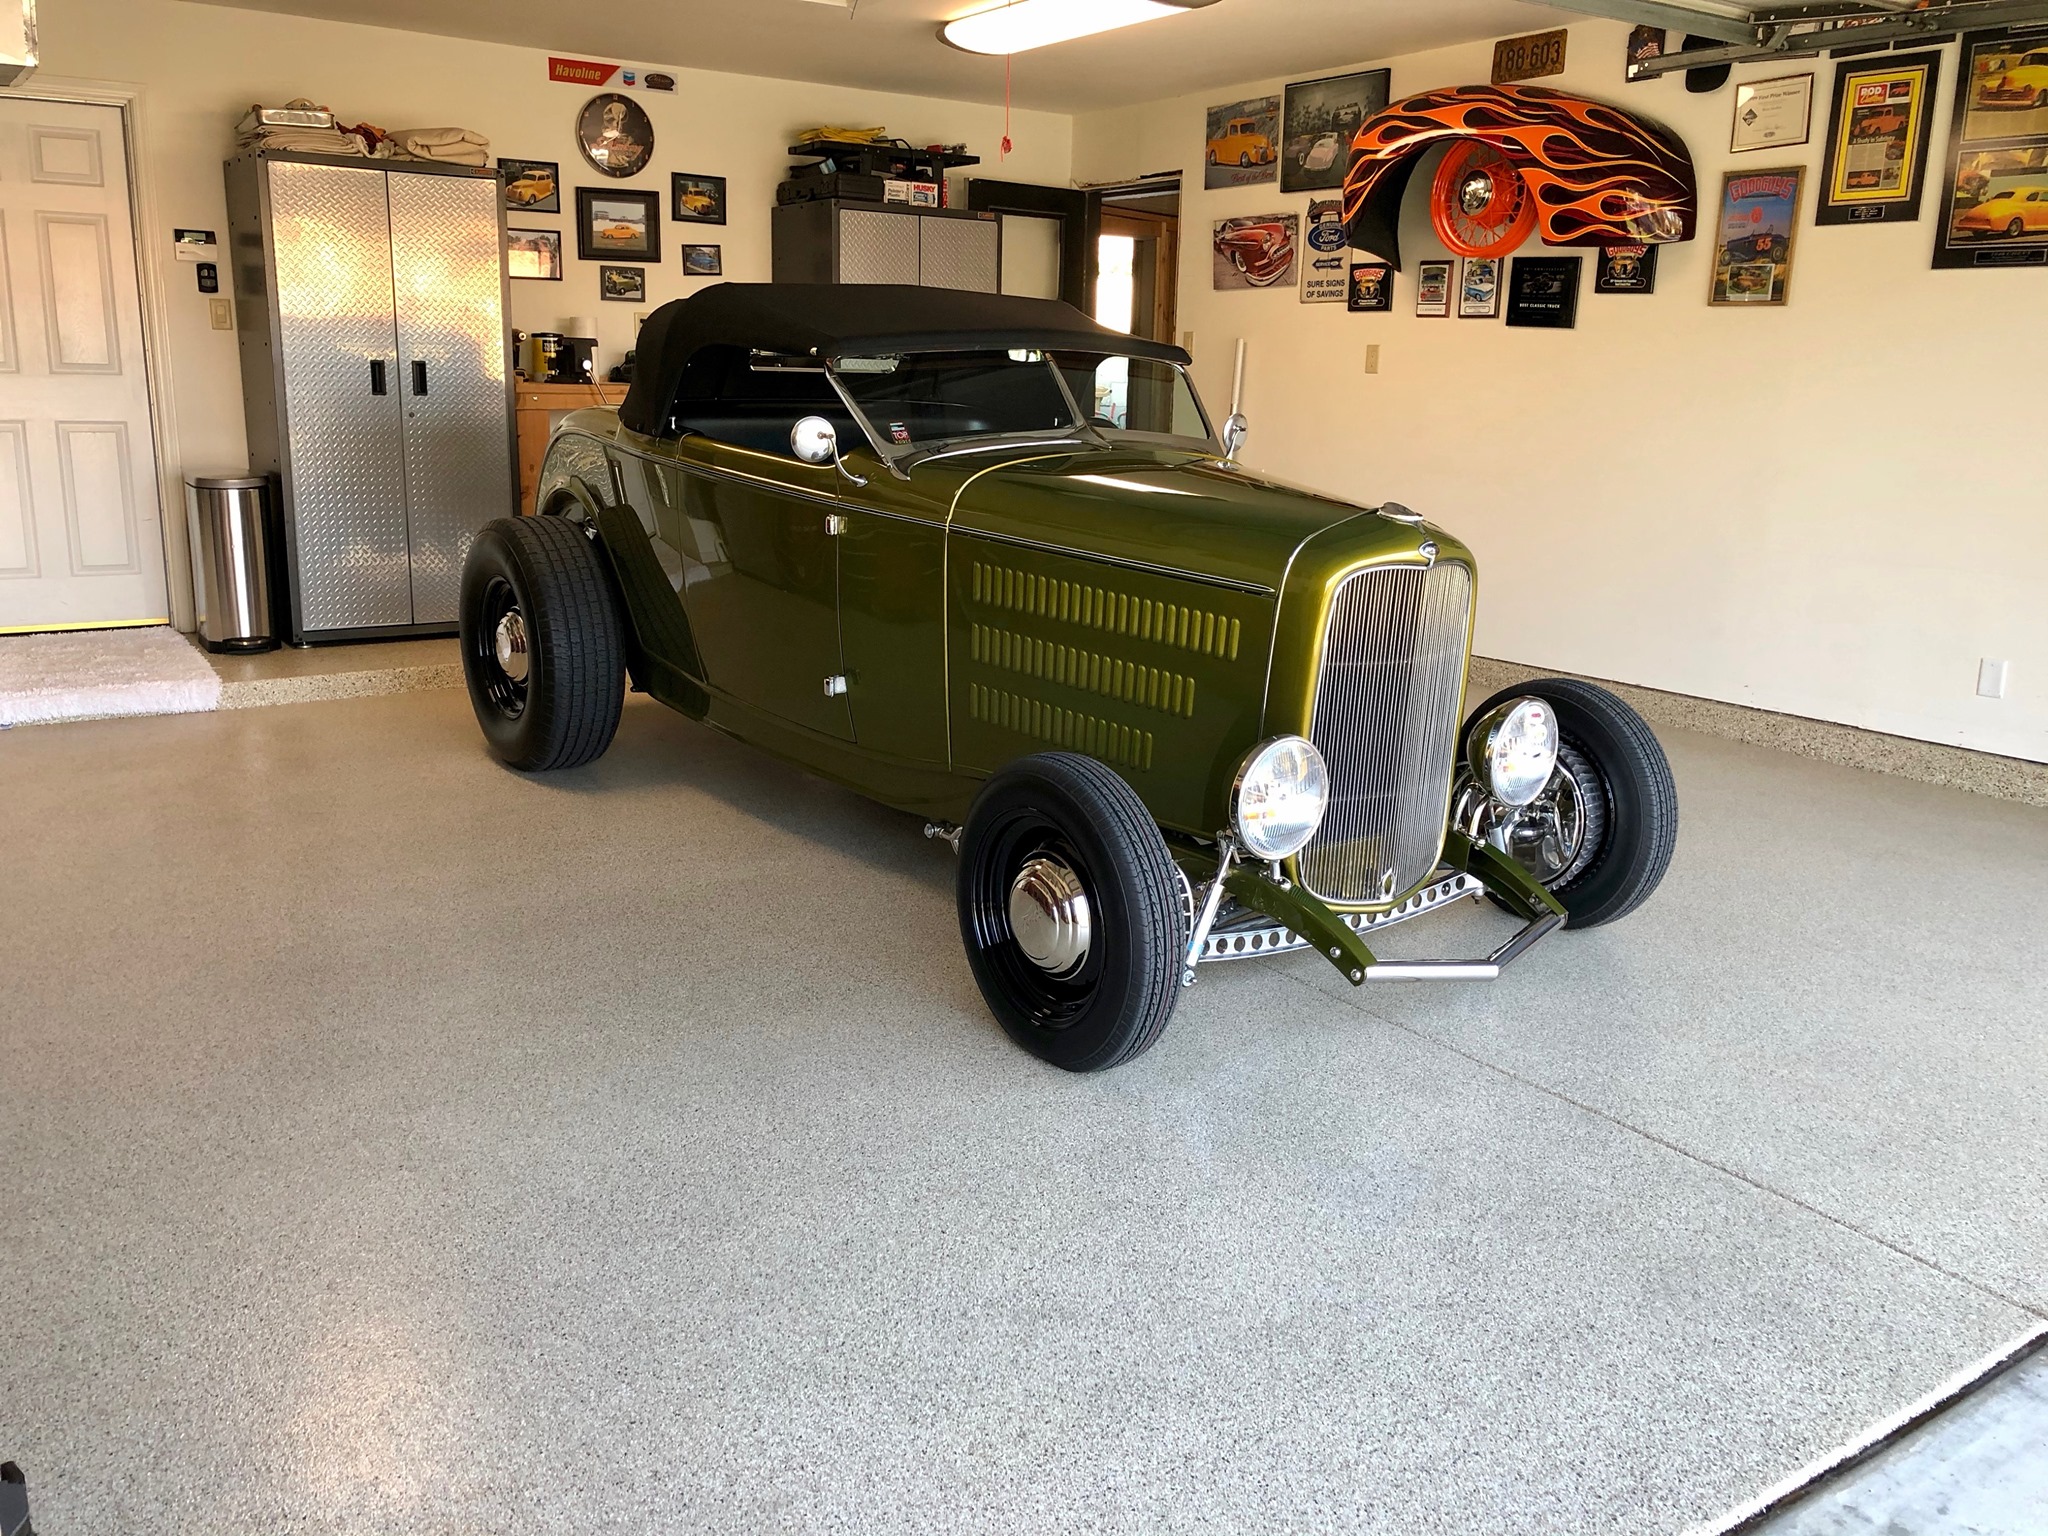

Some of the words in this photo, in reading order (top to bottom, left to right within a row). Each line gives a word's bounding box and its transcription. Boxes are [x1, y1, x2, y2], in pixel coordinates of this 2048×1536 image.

[555, 64, 601, 80] Havoline
[1860, 86, 1882, 96] ROD
[913, 184, 936, 192] HUSKY
[1728, 176, 1798, 204] GOODGUYS
[1319, 230, 1340, 242] Ford
[1756, 238, 1772, 251] 55
[1307, 280, 1324, 288] SURE
[1326, 279, 1345, 287] SIGNS
[1317, 290, 1344, 298] SAVINGS
